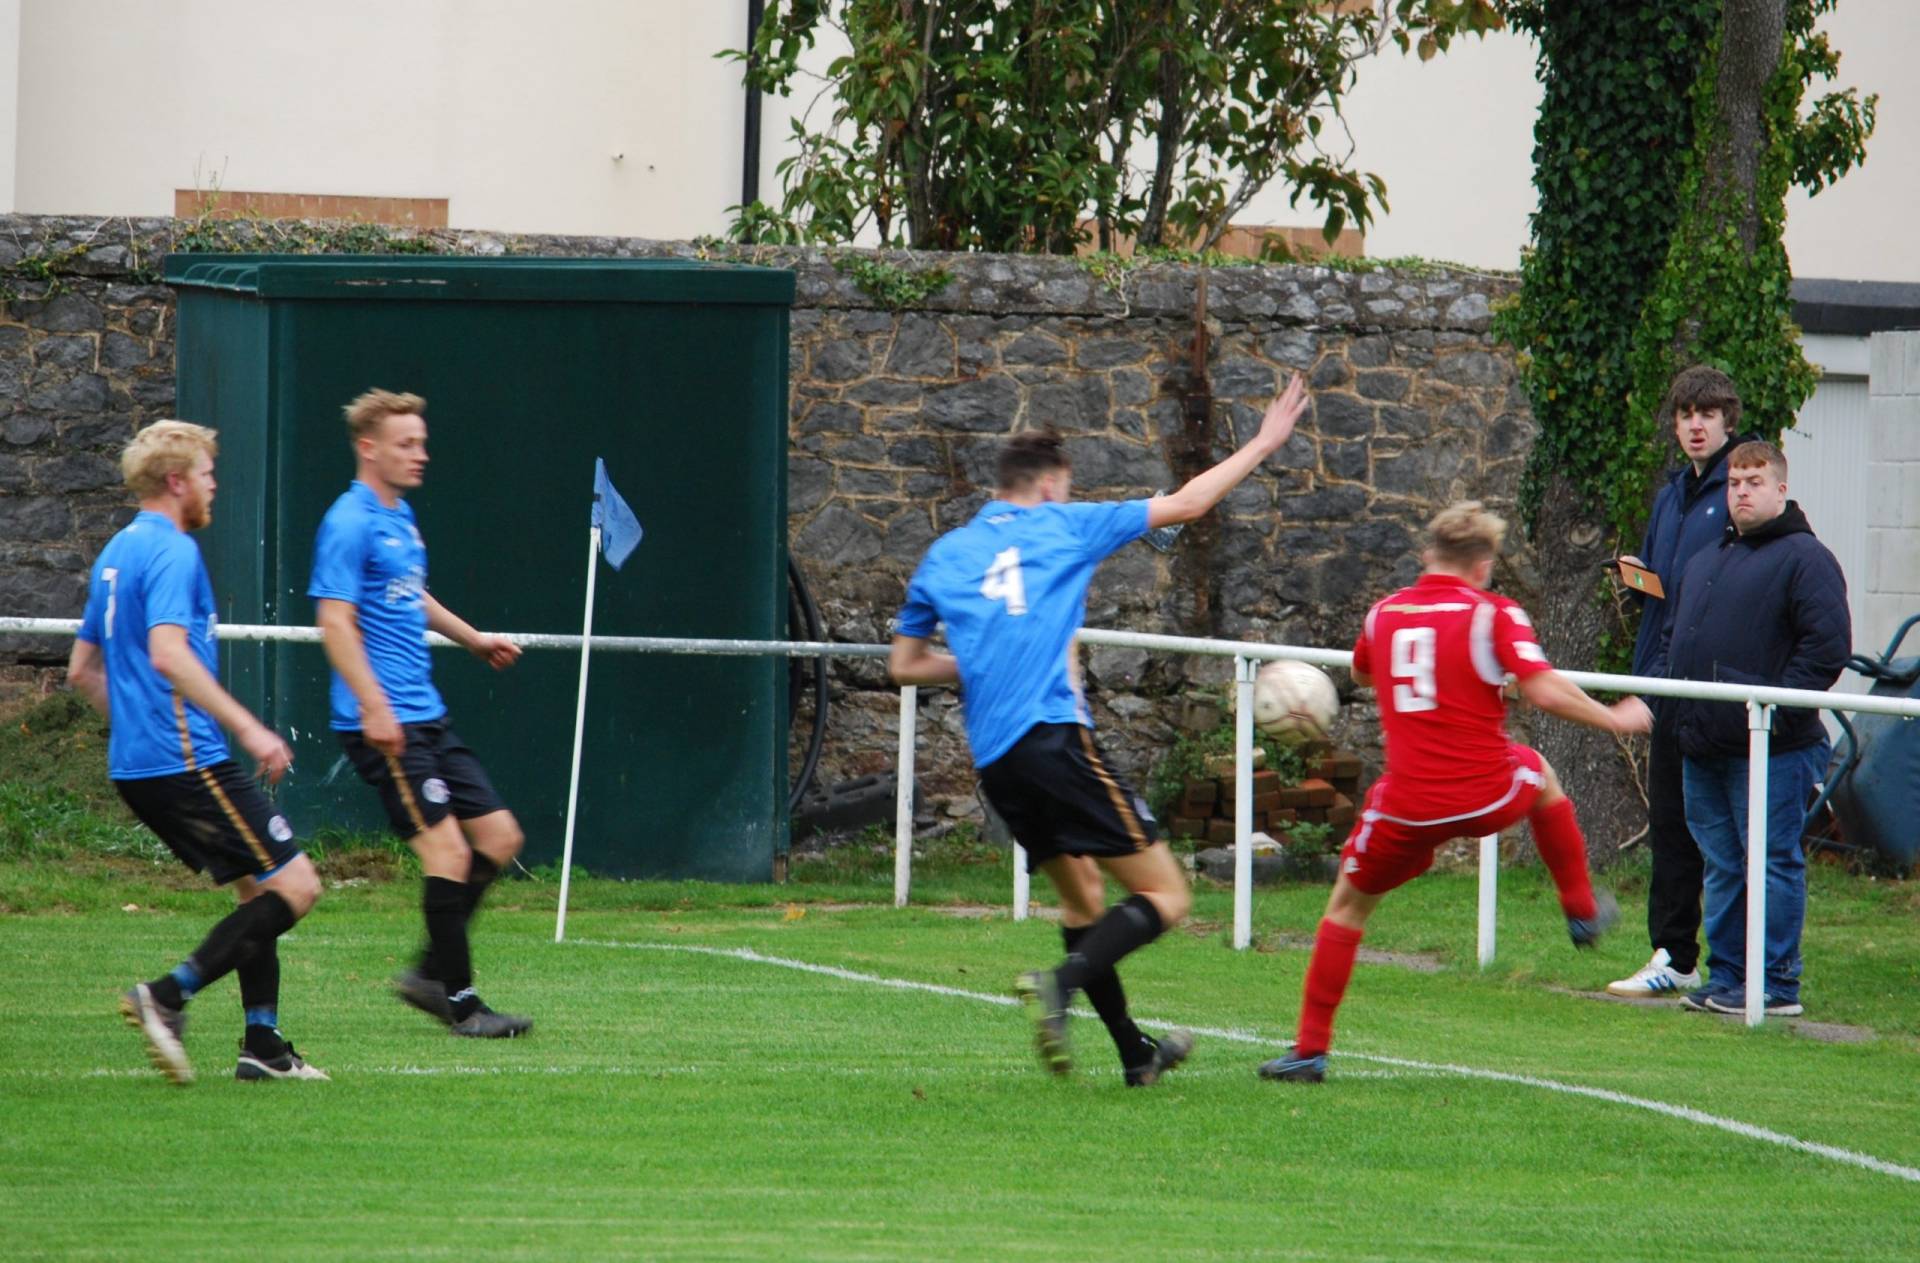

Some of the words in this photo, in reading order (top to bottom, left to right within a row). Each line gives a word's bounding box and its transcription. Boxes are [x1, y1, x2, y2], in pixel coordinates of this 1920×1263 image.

[101, 567, 118, 640] 7
[980, 546, 1028, 616] 4
[1391, 627, 1438, 713] 9
